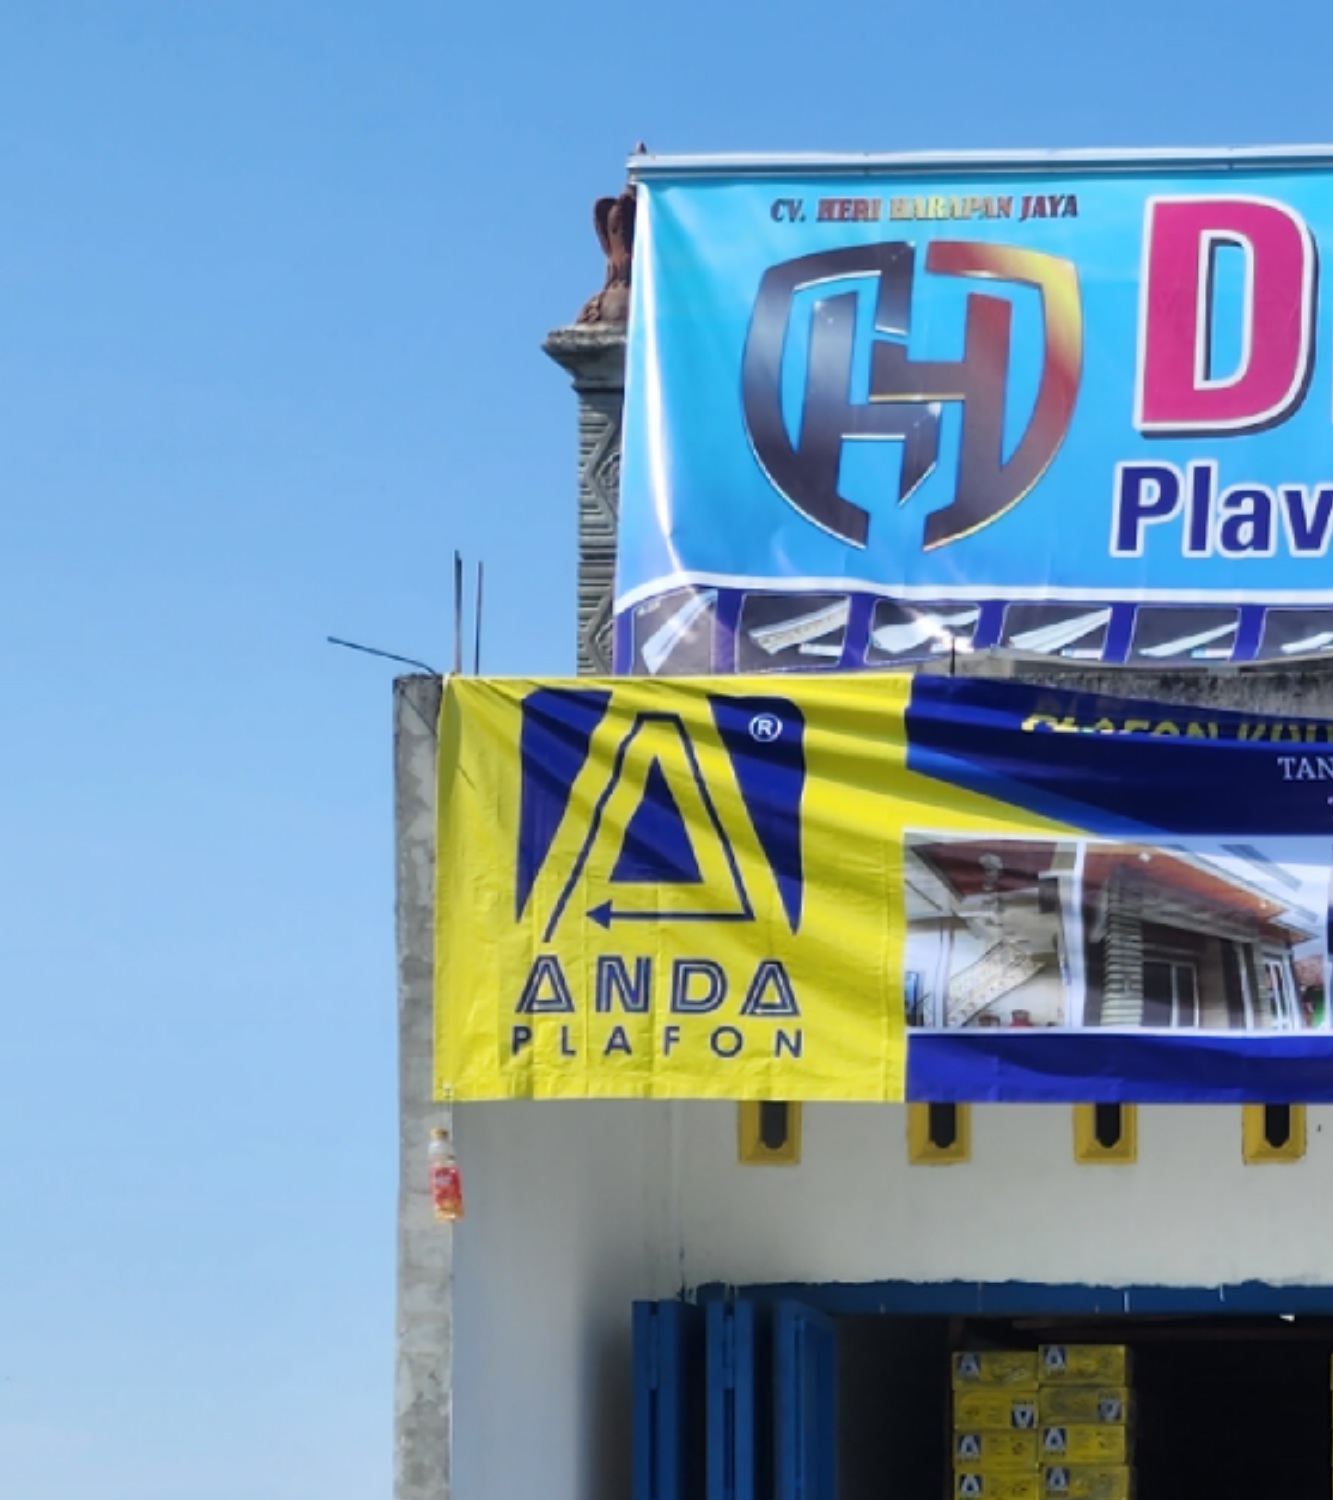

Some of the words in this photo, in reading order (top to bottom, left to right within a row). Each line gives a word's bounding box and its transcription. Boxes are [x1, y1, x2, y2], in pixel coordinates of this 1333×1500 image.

[770, 198, 806, 223] CV.
[889, 196, 1013, 221] HARAPAN
[1018, 194, 1079, 222] JAYA
[514, 954, 800, 1017] ANDA
[511, 1025, 804, 1058] PLAFON
